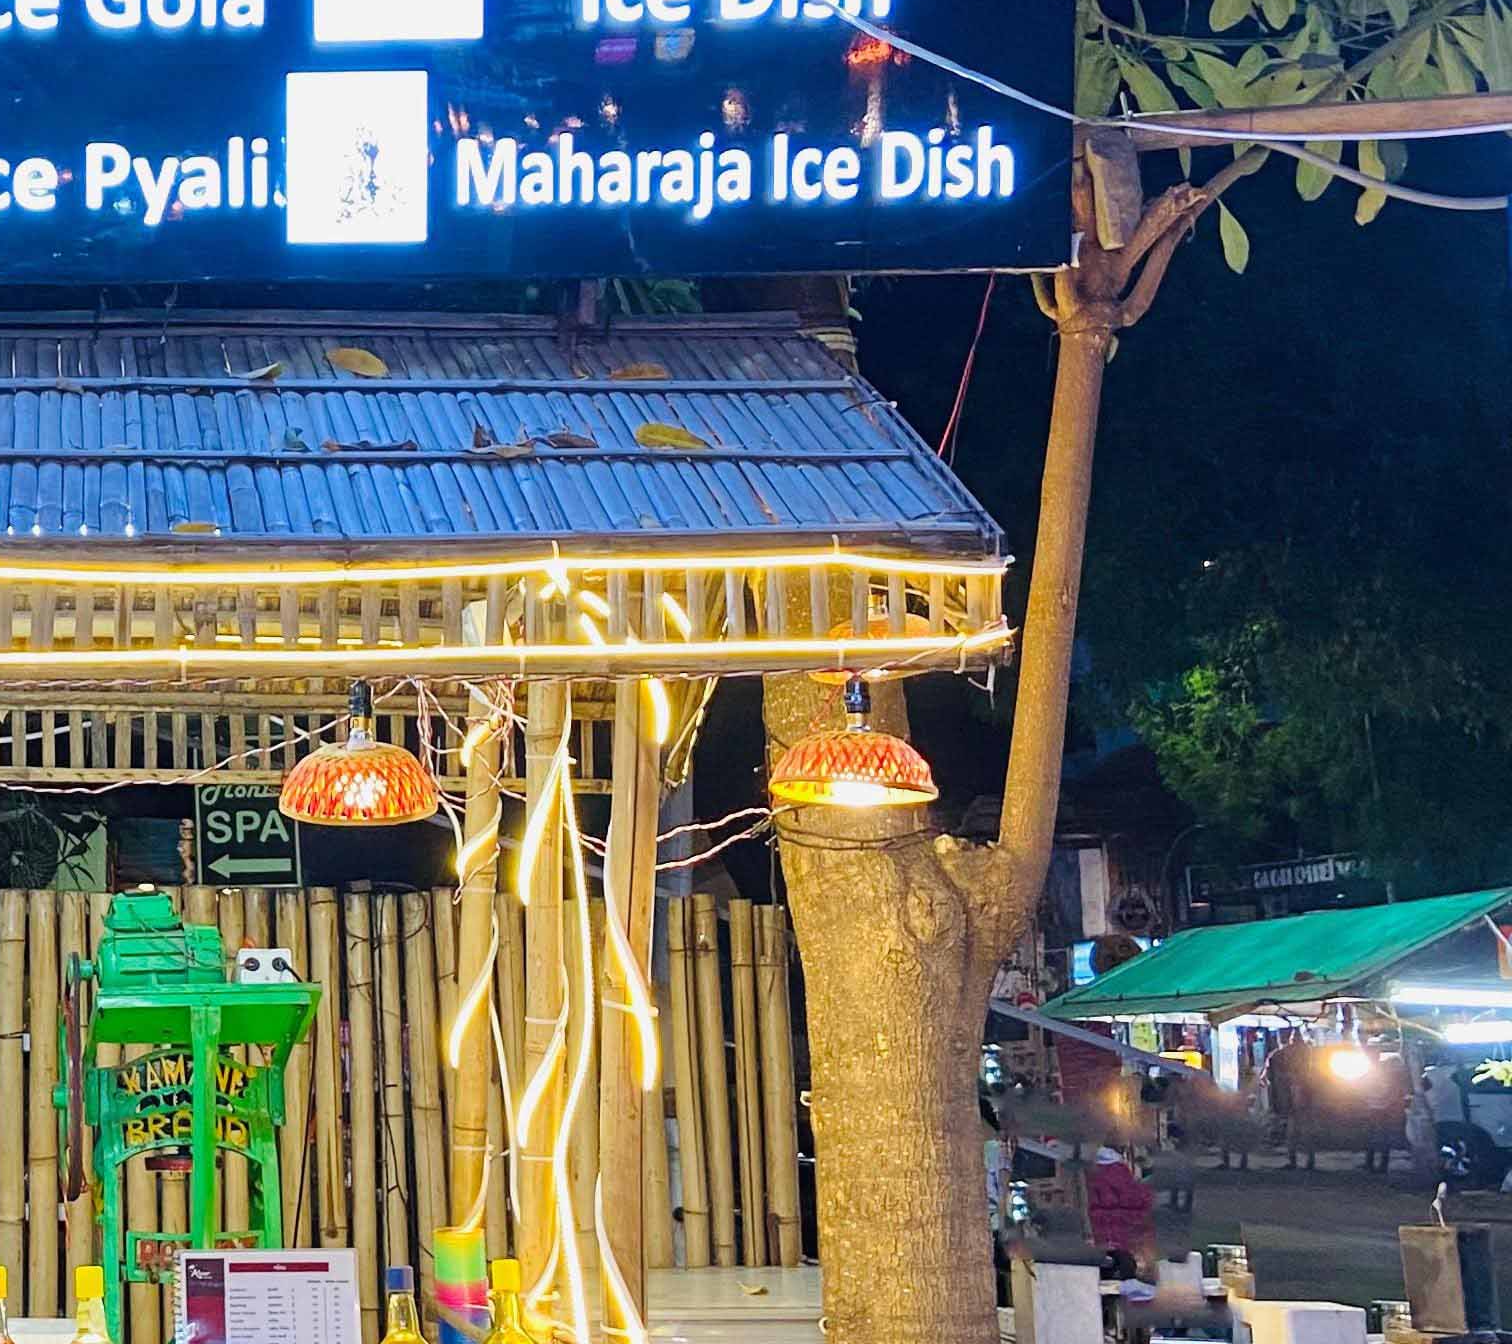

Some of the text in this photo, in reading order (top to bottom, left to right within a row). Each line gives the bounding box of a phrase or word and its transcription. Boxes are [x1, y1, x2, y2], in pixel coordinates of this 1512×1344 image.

[85, 137, 269, 226] Pyali
[456, 125, 1015, 219] Maharaja Ice Dish
[206, 810, 290, 844] SPA
